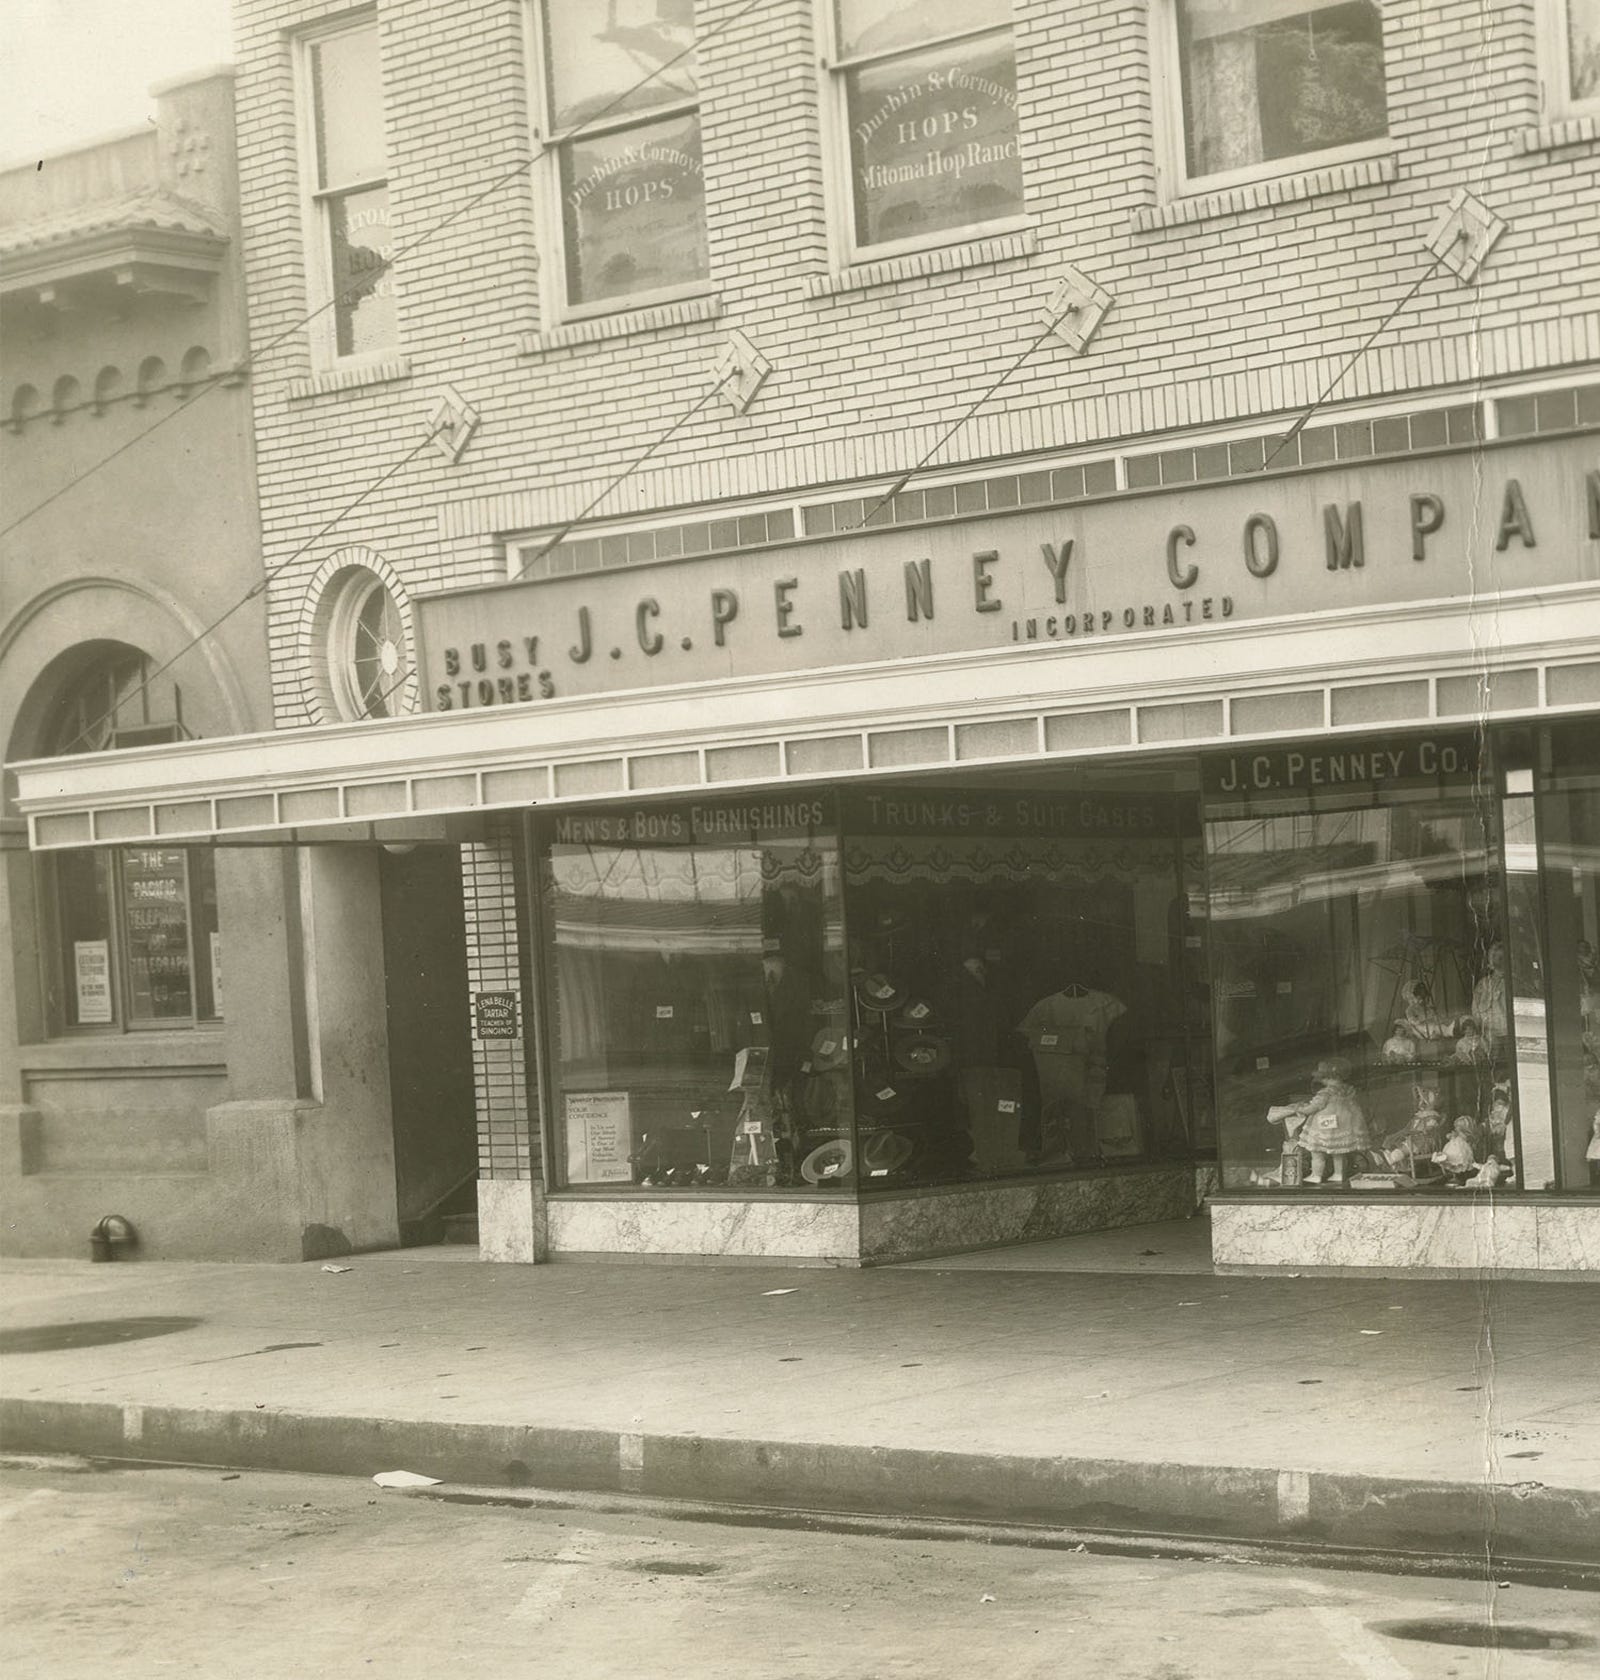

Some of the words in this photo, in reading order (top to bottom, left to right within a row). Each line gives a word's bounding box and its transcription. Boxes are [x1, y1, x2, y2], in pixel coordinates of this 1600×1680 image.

[857, 84, 922, 144] Durbin
[927, 71, 945, 92] &
[898, 105, 979, 144] HOPS
[568, 154, 623, 208] Durbin
[926, 150, 966, 179] Hop
[606, 178, 674, 211] HOPS
[1012, 596, 1234, 641] INCORPORATED
[445, 635, 539, 677] BUSY
[437, 670, 556, 712] STORES
[556, 814, 611, 844] MEN'S
[617, 817, 630, 841] &
[634, 810, 682, 839] BOYS
[691, 801, 824, 834] FURNISHINGS
[867, 795, 970, 826] TRUNKS
[986, 806, 1001, 826] &
[1016, 800, 1066, 827] SUIT
[1079, 800, 1153, 828] CASES
[141, 851, 163, 868] THE
[133, 879, 177, 899] PACIFIC
[480, 1027, 513, 1036] SINGING
